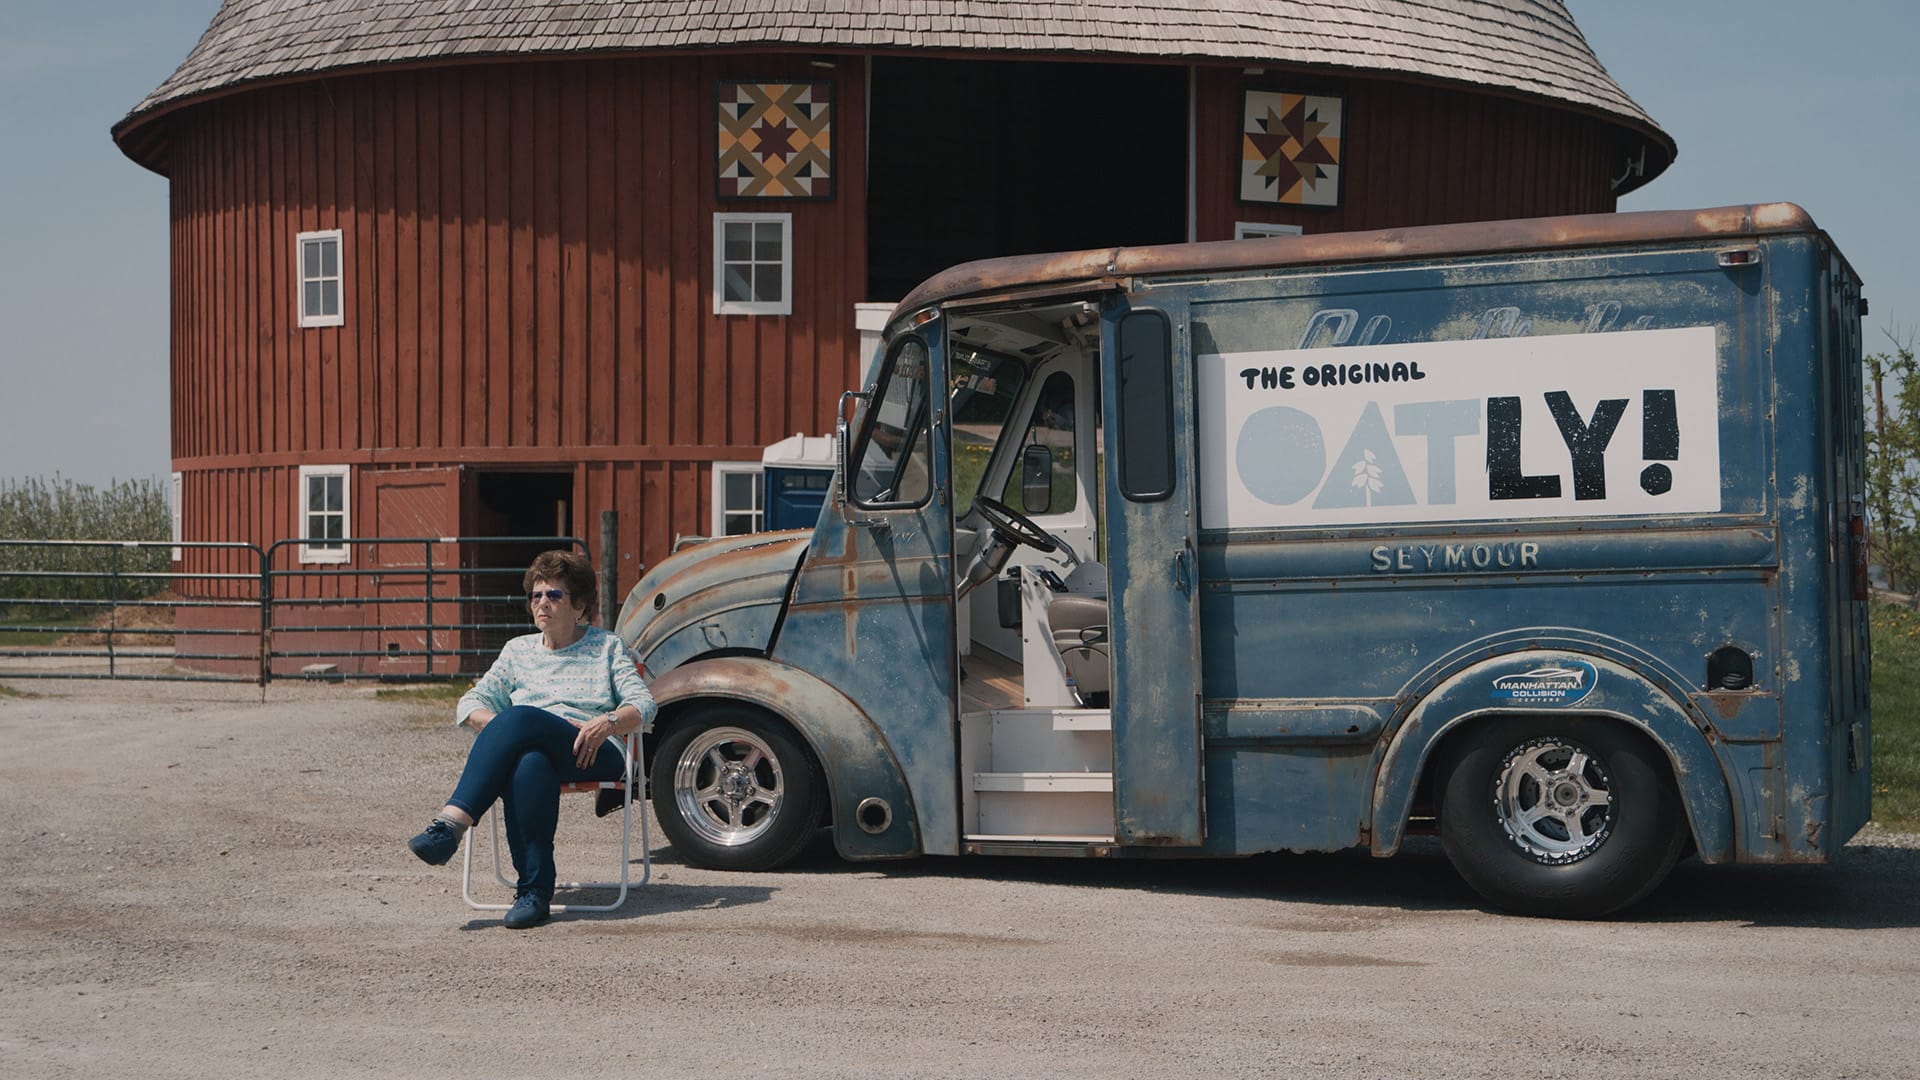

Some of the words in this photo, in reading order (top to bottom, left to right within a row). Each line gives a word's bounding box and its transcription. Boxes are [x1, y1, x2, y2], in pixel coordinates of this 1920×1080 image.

[1240, 365, 1296, 390] THE
[1303, 360, 1426, 387] ORIGINAL
[1235, 389, 1680, 510] OATLY!
[1370, 542, 1540, 572] SEYMOUR
[1500, 681, 1578, 690] MANHATTAN
